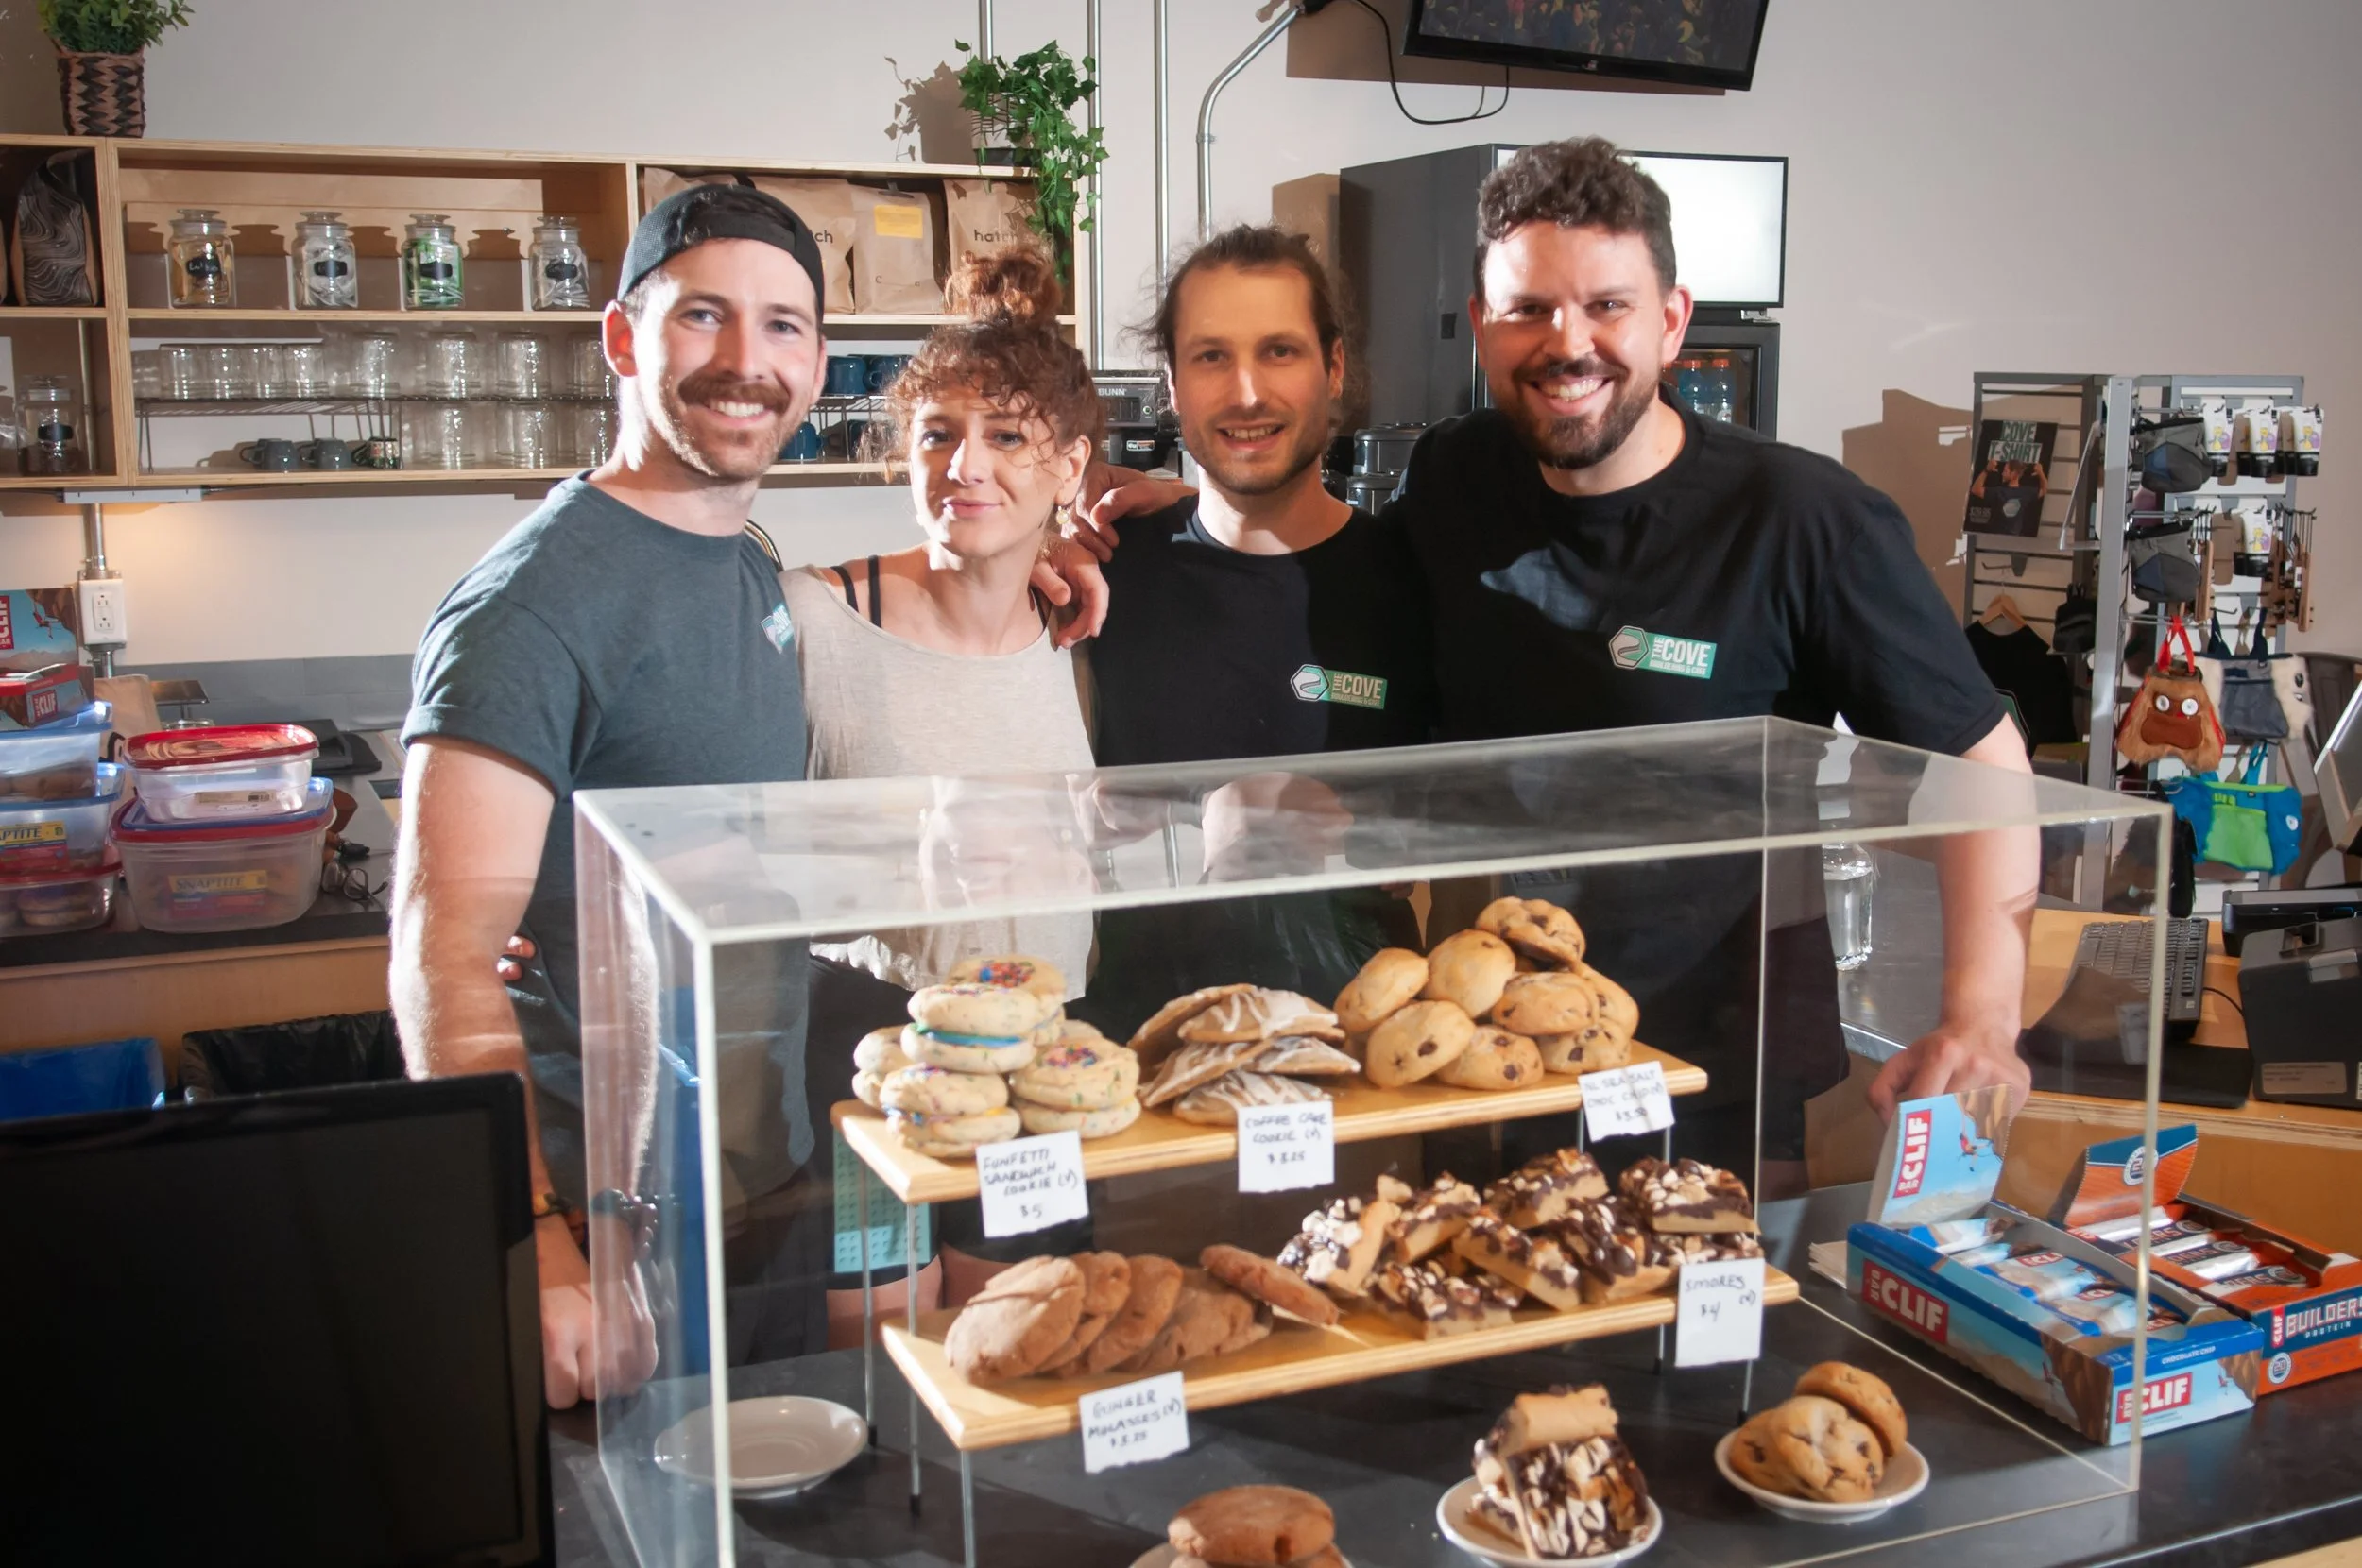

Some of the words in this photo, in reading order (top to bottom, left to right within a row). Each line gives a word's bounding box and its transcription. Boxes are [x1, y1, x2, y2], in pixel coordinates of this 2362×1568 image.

[2000, 421, 2036, 442] COVE
[1988, 441, 2042, 462] T-SHIRT
[1662, 639, 1711, 667] COVE
[1341, 674, 1383, 699] COVE
[39, 693, 56, 715] CLIF
[1252, 1129, 1295, 1143] COOKIE
[1901, 1117, 1928, 1180] CLIF
[983, 1148, 1050, 1171] FUNFETTI
[984, 1160, 1057, 1185] SANDWICH
[1898, 1179, 1920, 1191] BAR
[1003, 1176, 1051, 1197] COOKIE
[1871, 1269, 1881, 1301] BAR
[1881, 1277, 1943, 1331] CLIF
[2273, 1314, 2283, 1345] CLIF
[2305, 1321, 2351, 1338] PROTEIN
[1093, 1389, 1157, 1419] GINGER
[1087, 1410, 1162, 1439] MOLASSES
